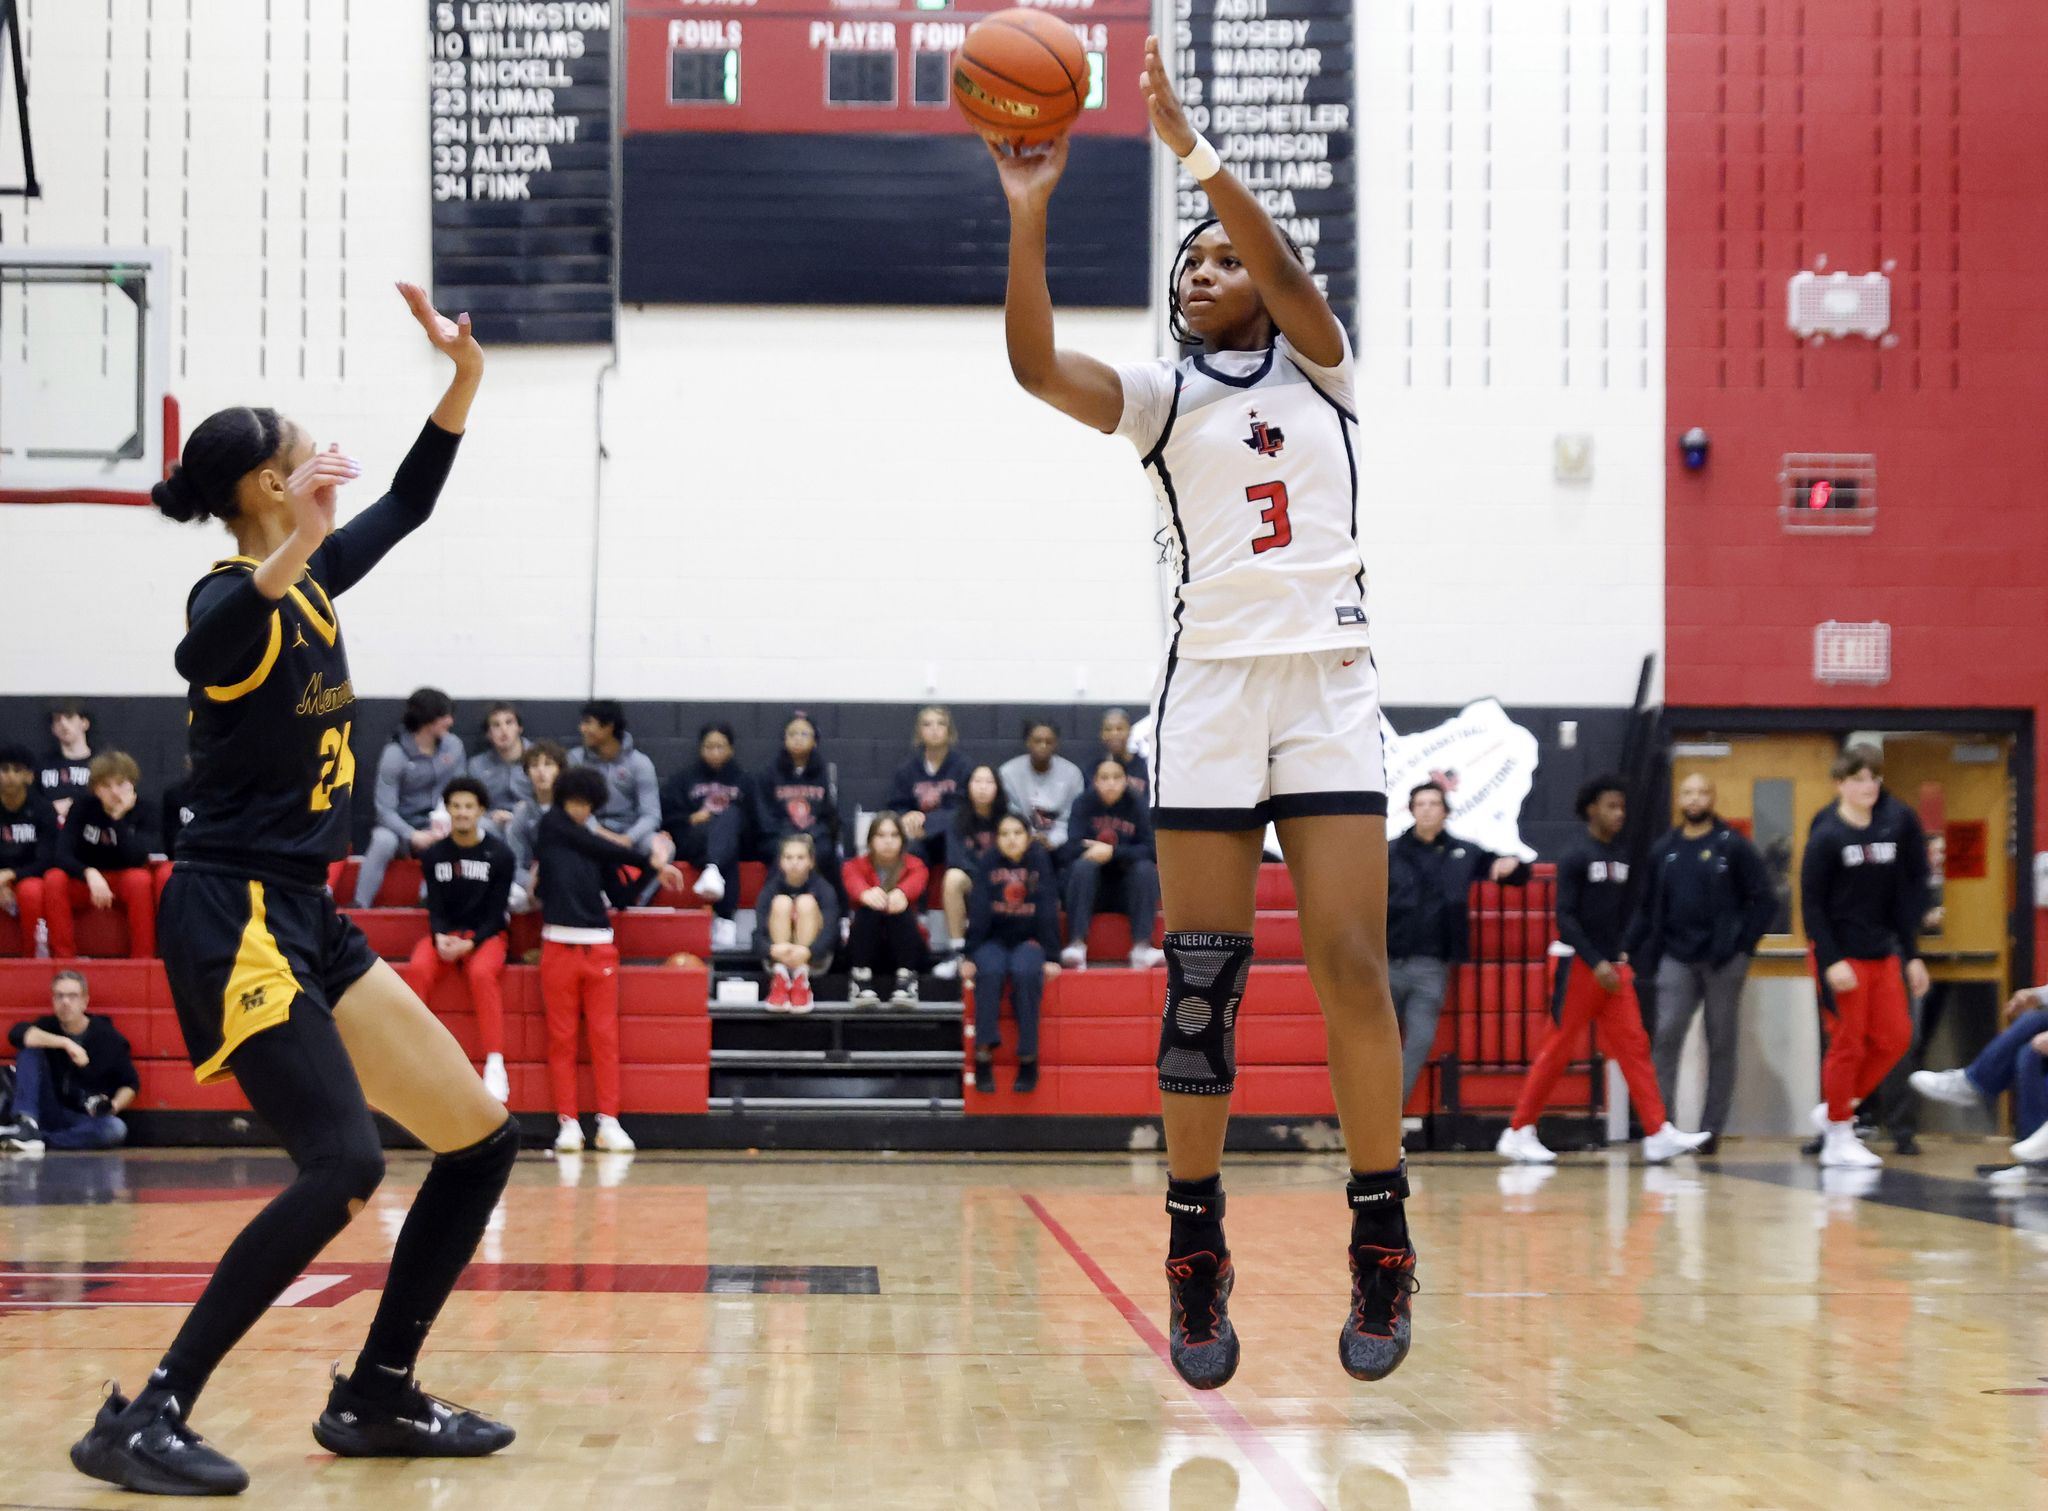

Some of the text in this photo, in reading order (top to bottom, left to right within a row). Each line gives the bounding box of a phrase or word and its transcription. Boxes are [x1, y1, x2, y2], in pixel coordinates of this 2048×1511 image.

[437, 2, 610, 31] 5 LEVINGSTON
[469, 31, 585, 59] WILLIAMS
[668, 19, 743, 48] FOULS
[809, 21, 896, 49] PLAYER
[432, 60, 573, 88] 22 NICKELL
[1212, 48, 1322, 76] WARRIOR
[724, 49, 738, 104] 1
[1212, 76, 1309, 104] MURPHY
[433, 88, 555, 116] 23 KUMAR
[433, 116, 580, 144] 24 LAURENT
[433, 145, 551, 172] 33 ALUGA
[1217, 132, 1328, 160] JOHNSON
[433, 173, 530, 200] 34 FINK
[1245, 480, 1292, 554] 3
